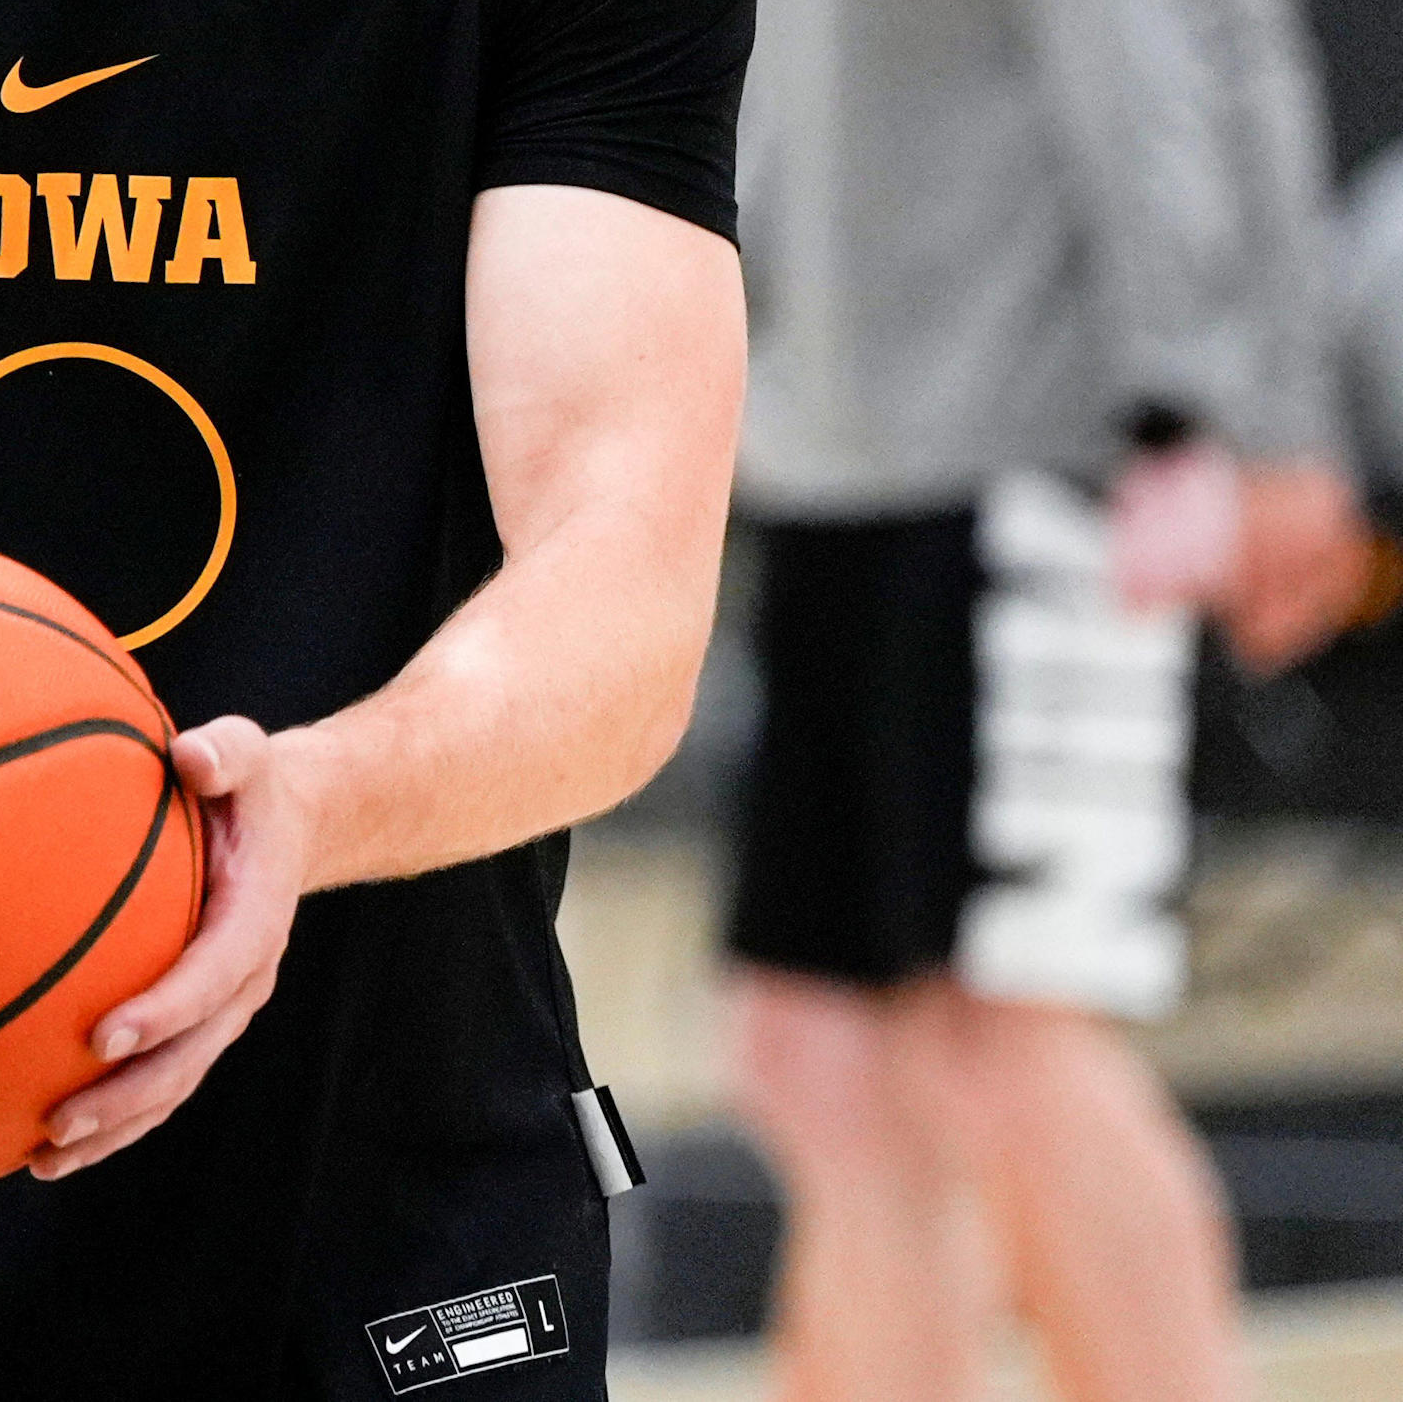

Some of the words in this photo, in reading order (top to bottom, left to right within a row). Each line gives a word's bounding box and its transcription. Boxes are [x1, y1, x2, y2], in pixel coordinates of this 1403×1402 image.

[436, 1291, 514, 1321] ENGINEERED
[538, 1300, 555, 1333] L
[393, 1352, 446, 1375] TEAM
